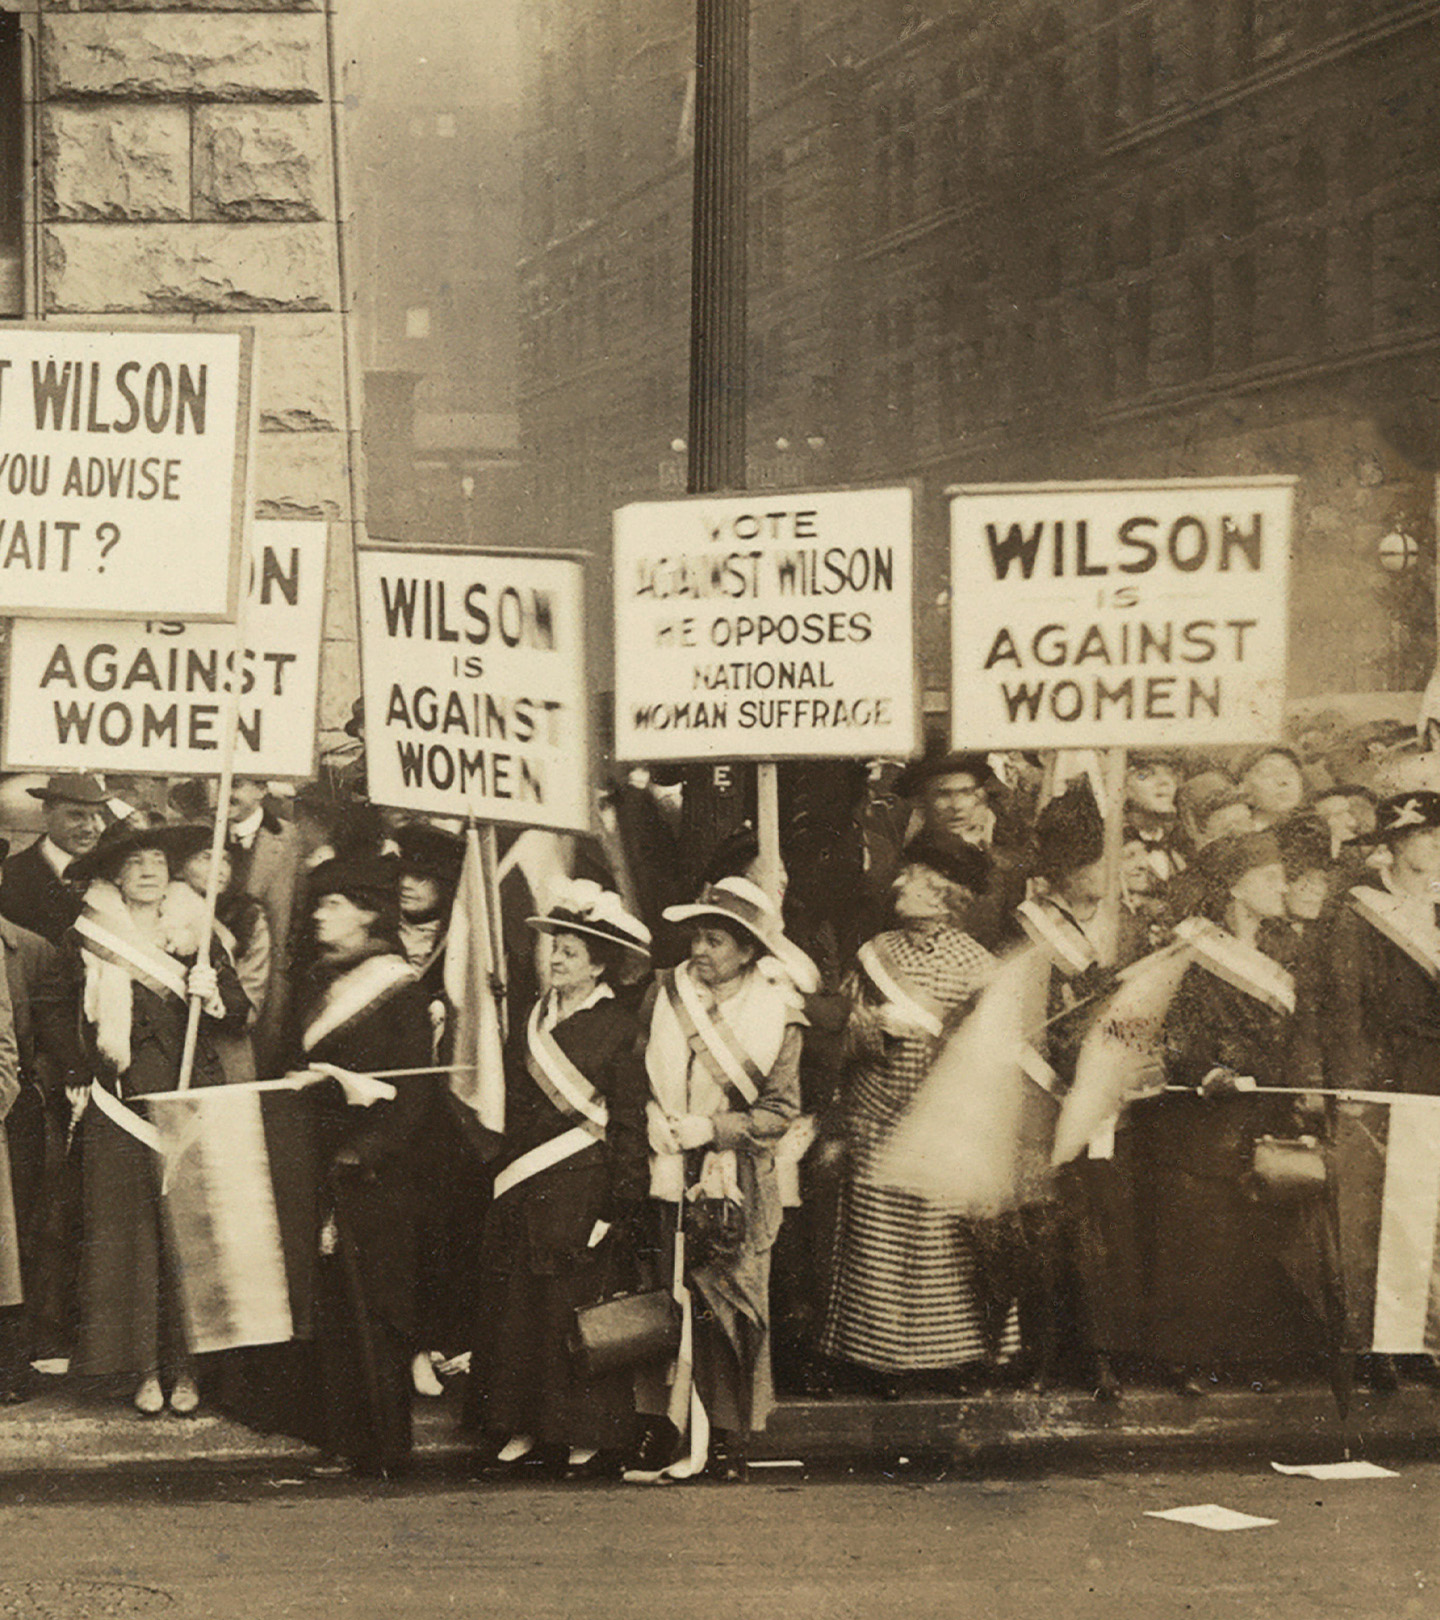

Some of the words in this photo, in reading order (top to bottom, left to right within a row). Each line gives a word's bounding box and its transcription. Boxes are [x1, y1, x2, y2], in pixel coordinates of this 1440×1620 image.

[31, 359, 208, 435] WILSON
[62, 456, 181, 501] ADVISE
[984, 512, 1264, 581] WILSON
[777, 547, 893, 597] WILSON
[380, 576, 557, 651] WILSON
[1096, 586, 1141, 611] IS
[710, 612, 872, 647] OPPOSES
[983, 619, 1257, 670] AGAINST
[39, 643, 297, 696] AGAINST
[453, 656, 484, 678] IS
[693, 661, 834, 690] NATIONAL
[385, 683, 563, 746] AGAINST
[738, 699, 892, 729] SUFFRAGE
[1001, 676, 1221, 723] WOMEN
[53, 700, 262, 752] WOMEN
[396, 740, 544, 804] WOMEN
